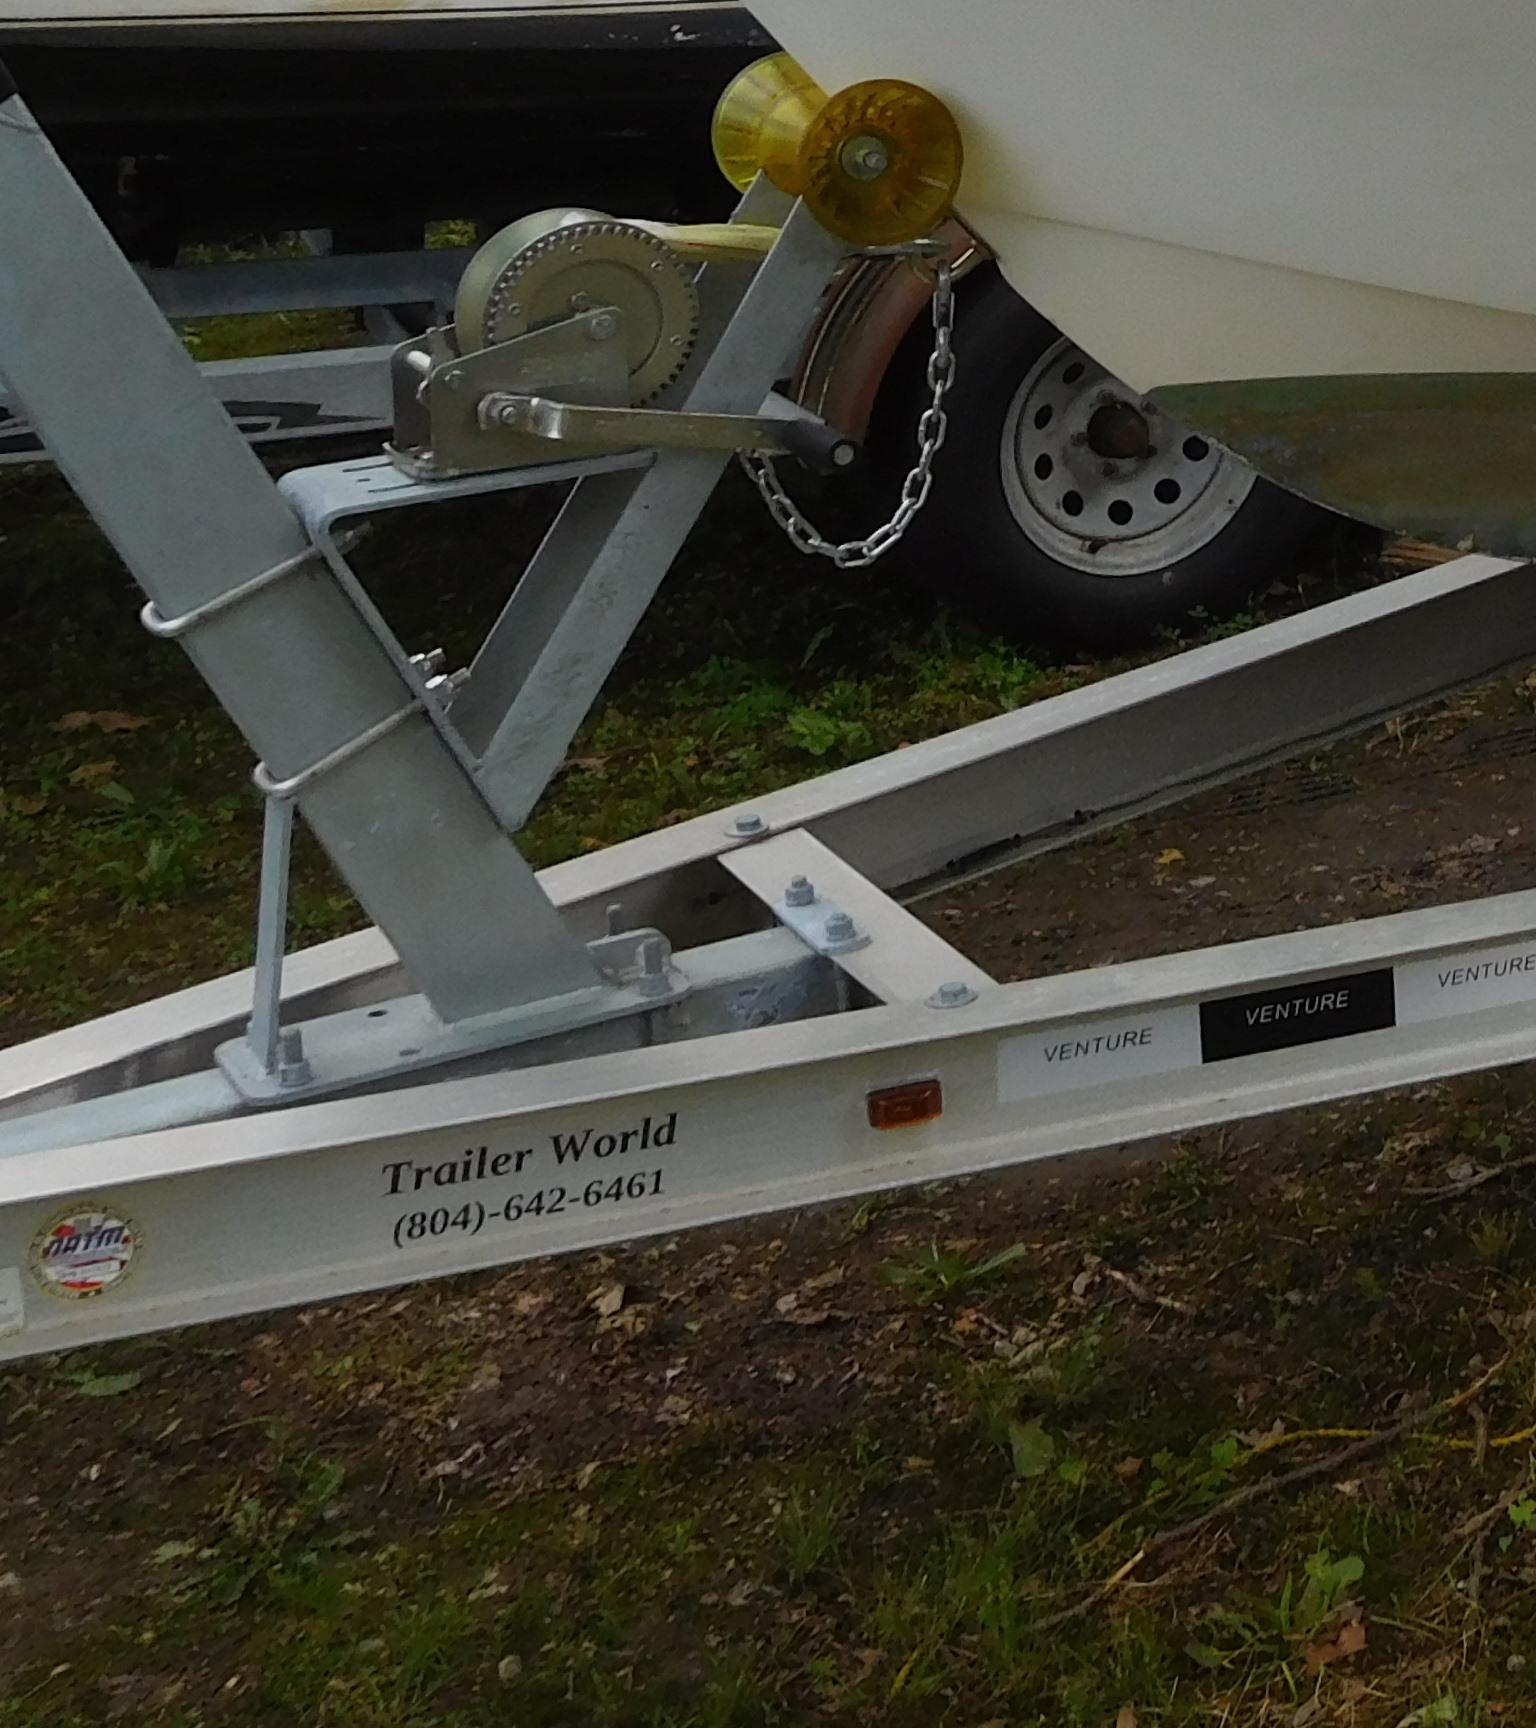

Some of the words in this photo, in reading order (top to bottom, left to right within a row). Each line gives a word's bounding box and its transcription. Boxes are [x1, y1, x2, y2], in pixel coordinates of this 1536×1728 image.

[1437, 954, 1536, 987] VENTURE
[1245, 990, 1350, 1026] VENTURE
[1043, 1027, 1153, 1062] VENTURE
[381, 1145, 534, 1198] Trailer
[549, 1112, 679, 1167] World
[393, 1167, 667, 1248] (804)-642-6461
